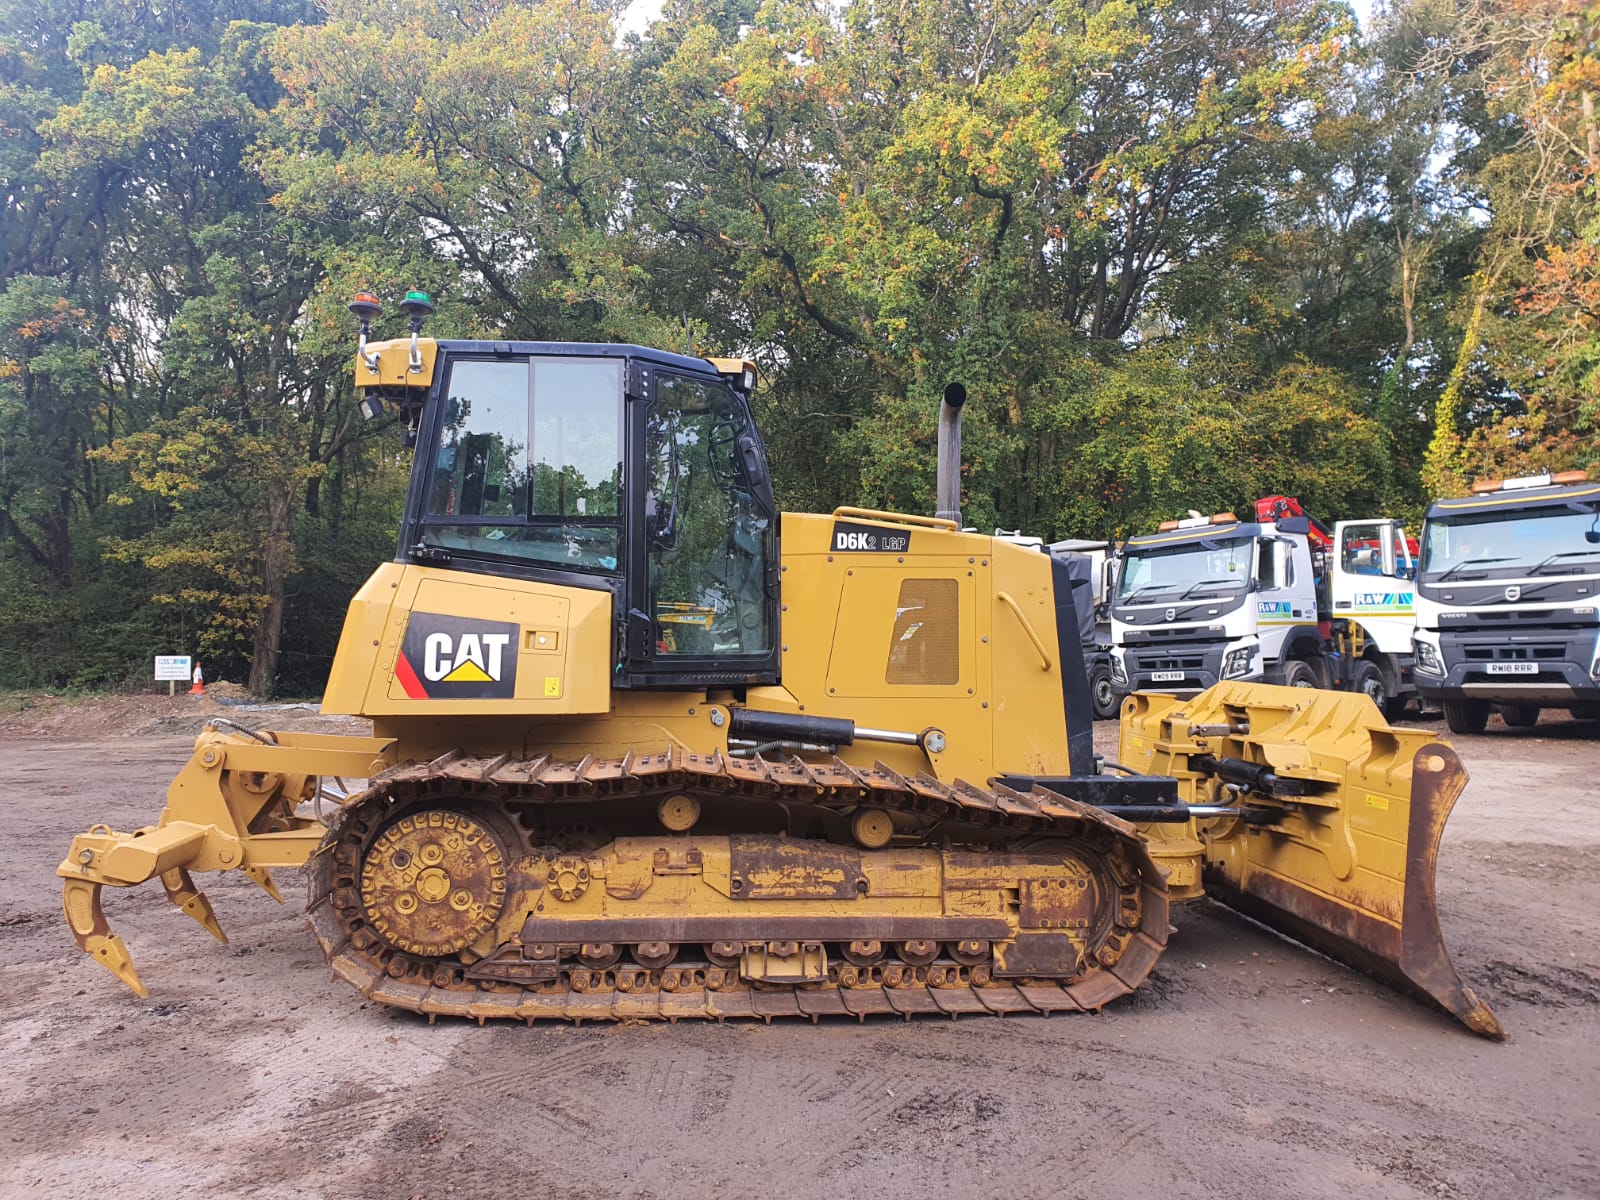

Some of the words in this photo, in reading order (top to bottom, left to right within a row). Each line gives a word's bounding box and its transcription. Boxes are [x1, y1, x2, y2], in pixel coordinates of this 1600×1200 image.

[836, 532, 877, 550] D6K2
[882, 536, 906, 550] LGP
[1355, 593, 1386, 605] R&W
[423, 632, 510, 682] CAT
[1514, 664, 1533, 673] RRR
